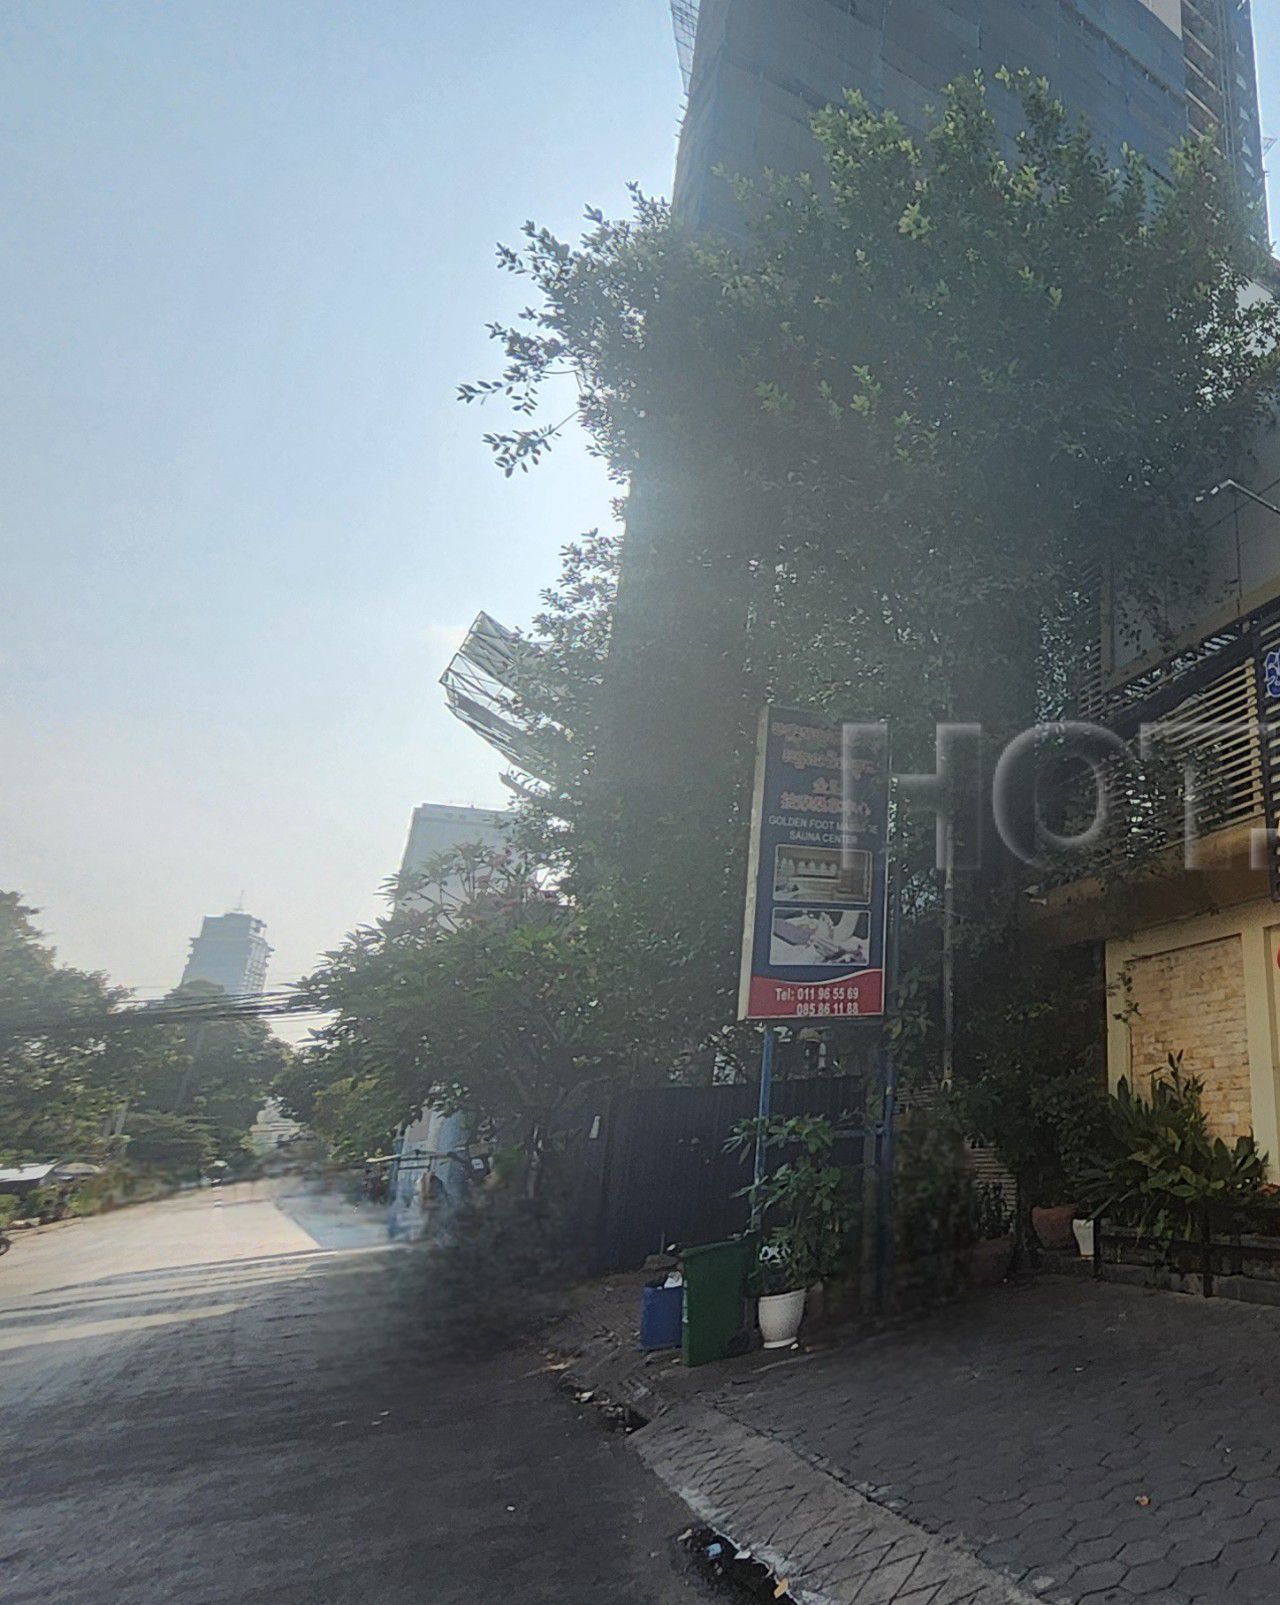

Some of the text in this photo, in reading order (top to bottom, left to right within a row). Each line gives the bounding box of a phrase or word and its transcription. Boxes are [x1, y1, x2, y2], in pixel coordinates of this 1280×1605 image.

[768, 814, 809, 829] GOLDEN
[808, 818, 837, 831] FOOT
[789, 829, 821, 842] SAUNA
[797, 987, 815, 1001] 011
[817, 988, 831, 1001] 96
[832, 987, 845, 1001] 55
[796, 1001, 816, 1016] 085
[833, 1002, 844, 1015] 11
